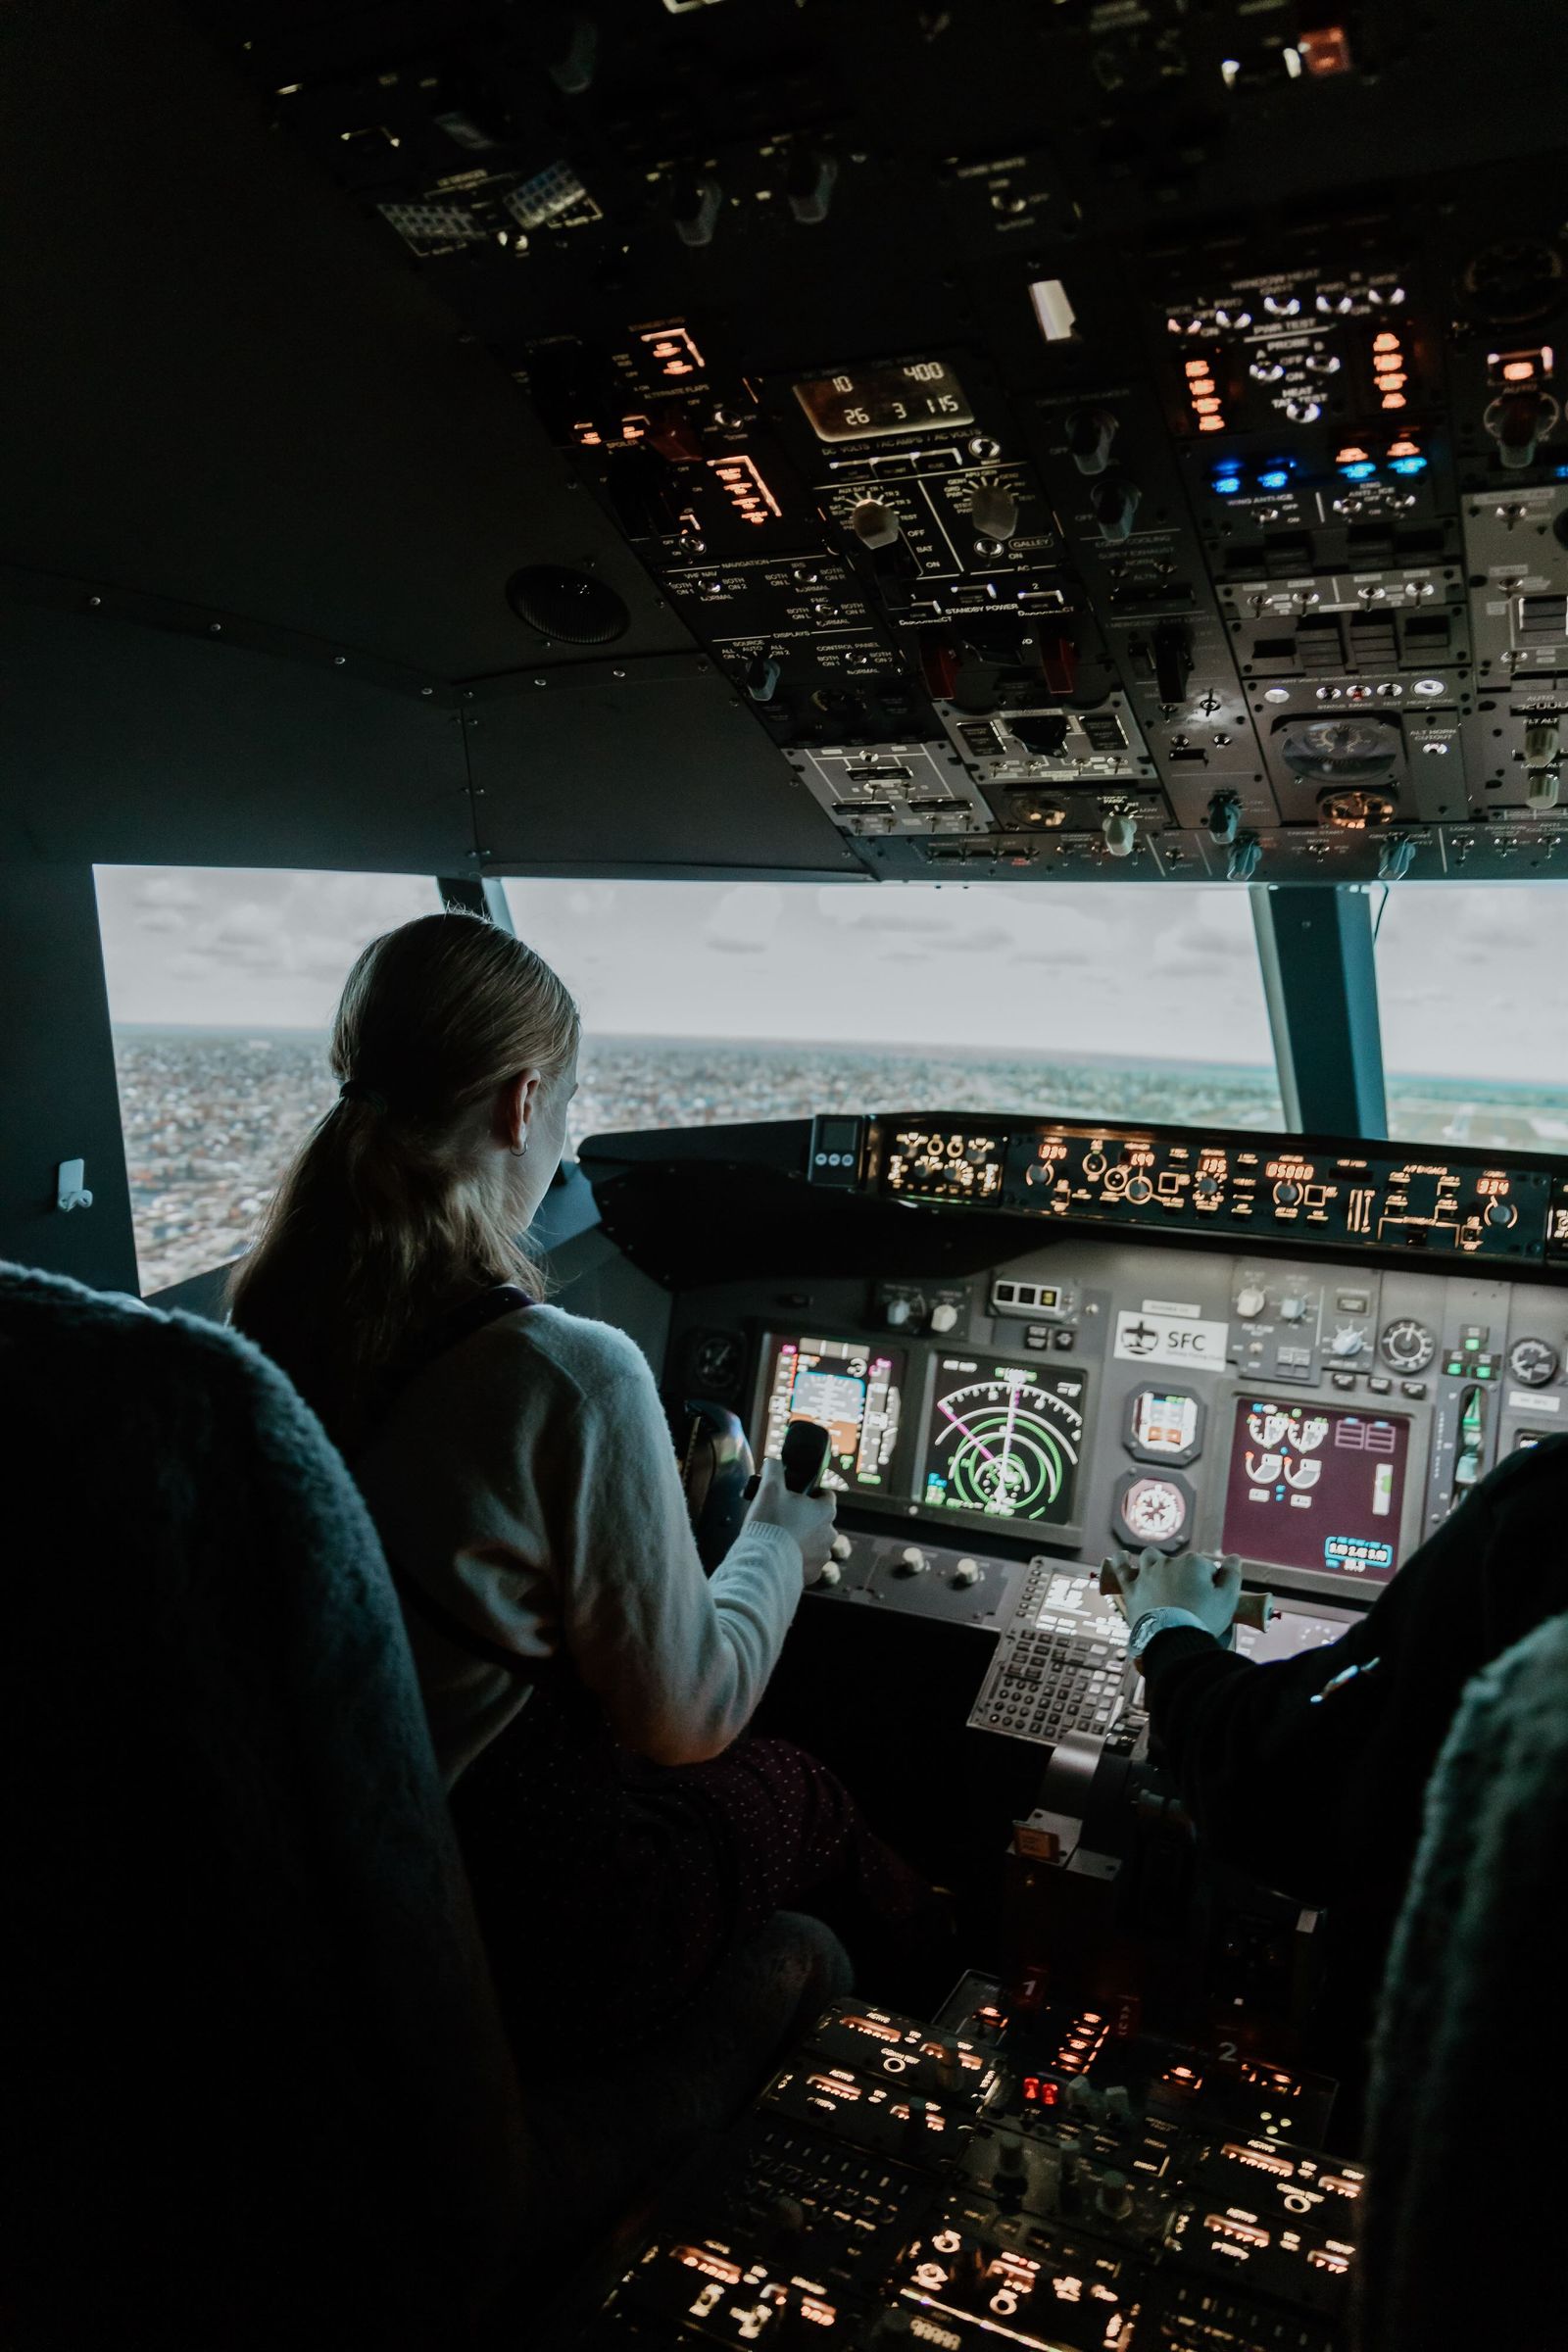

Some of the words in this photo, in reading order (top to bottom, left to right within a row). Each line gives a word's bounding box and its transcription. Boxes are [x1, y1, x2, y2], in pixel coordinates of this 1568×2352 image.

[1285, 269, 1321, 280] HEAT
[1286, 318, 1317, 329] TEST
[1267, 337, 1310, 351] PROBE
[1280, 355, 1304, 366] OFF
[832, 375, 853, 392] 10
[903, 362, 944, 381] 400
[1286, 371, 1306, 382] ON
[1282, 386, 1313, 398] HEAT
[1296, 392, 1329, 404] TEST
[843, 408, 870, 425] 26
[892, 402, 907, 418] 3
[841, 443, 870, 453] VOLTS
[950, 428, 983, 439] VOLTS
[1227, 498, 1252, 507] WING
[1253, 493, 1294, 504] ANTI-ICE
[1013, 538, 1049, 548] GALLEY
[721, 559, 770, 568] NAVIGATION
[819, 567, 844, 576] BOTH
[721, 576, 745, 585] BOTH
[945, 606, 984, 615] STANDBY
[986, 604, 1019, 612] POWER
[773, 630, 810, 639] DISPLAYS
[732, 639, 765, 648] SOURCE
[816, 643, 853, 652] CONTROL
[1478, 1180, 1509, 1195] 334
[1167, 1331, 1205, 1351] SFC
[1022, 1980, 1037, 1996] 1
[866, 2012, 891, 2024] ACTIVE
[1217, 2042, 1239, 2062] 2
